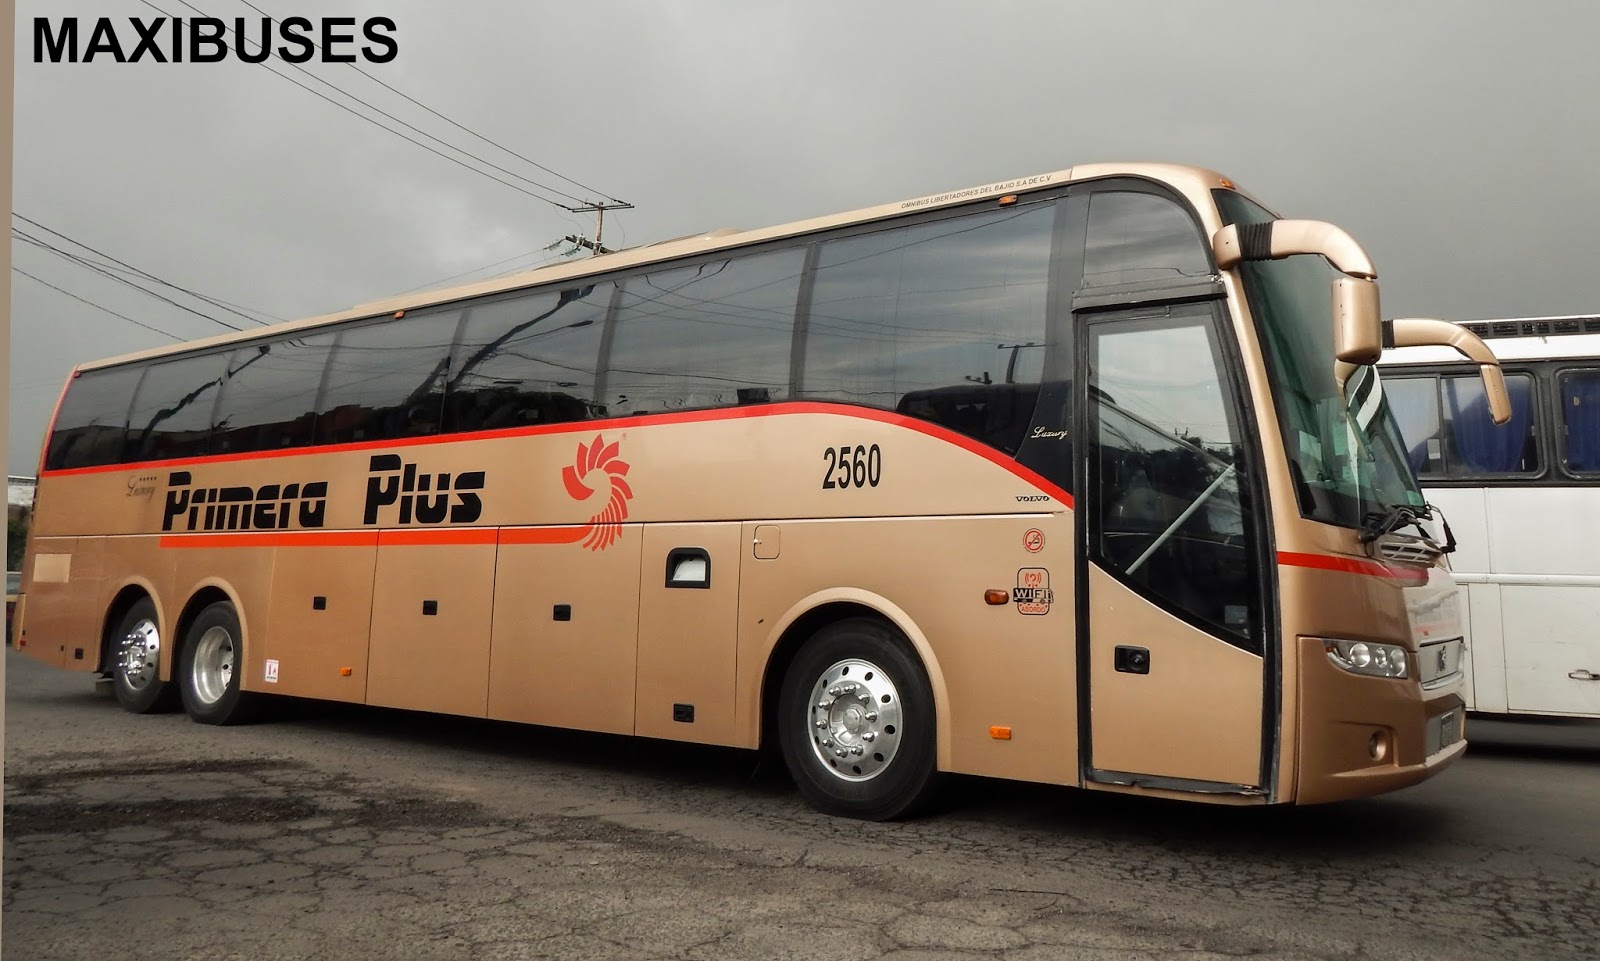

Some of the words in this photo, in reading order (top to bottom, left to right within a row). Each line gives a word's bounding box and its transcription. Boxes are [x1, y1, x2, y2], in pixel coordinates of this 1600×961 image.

[901, 198, 930, 209] OMNIBUS
[930, 189, 979, 204] LIBERTADORES
[980, 186, 993, 194] DEL
[1028, 177, 1038, 185] DE
[1030, 426, 1067, 440] Luxury
[822, 443, 881, 490] 2560
[162, 470, 328, 531] Primera
[363, 453, 486, 525] Plus
